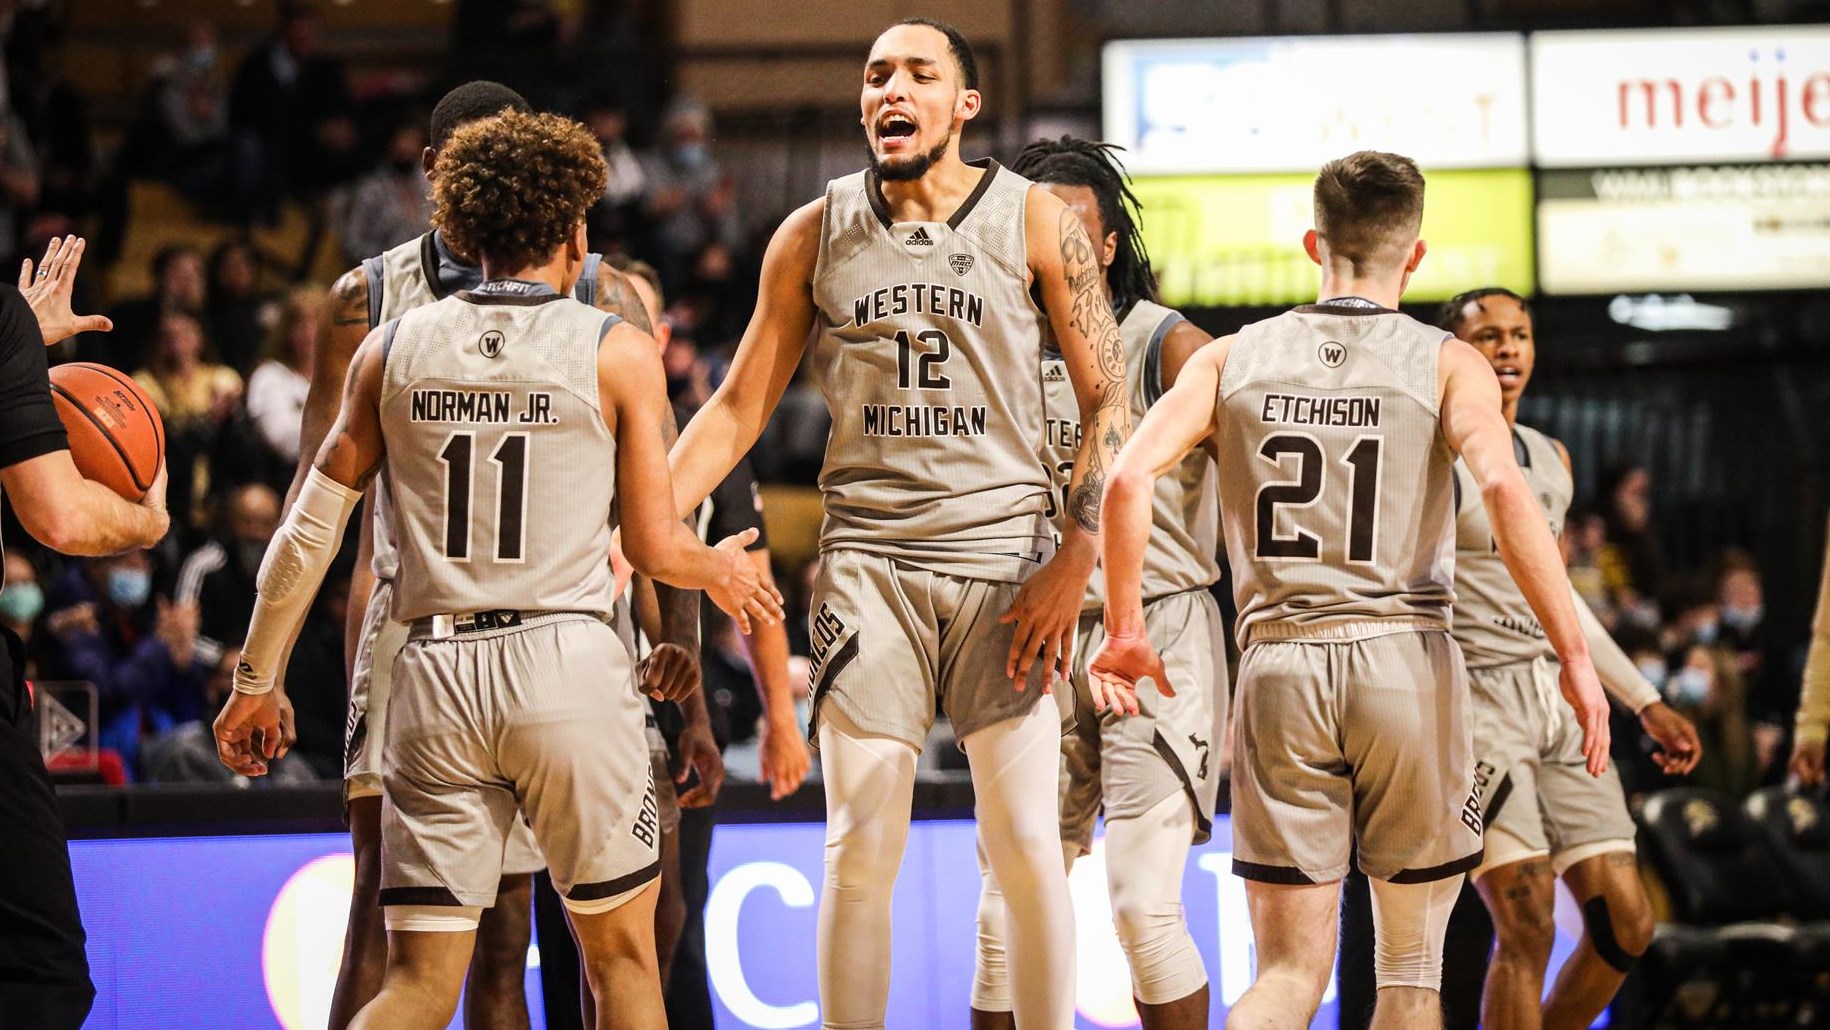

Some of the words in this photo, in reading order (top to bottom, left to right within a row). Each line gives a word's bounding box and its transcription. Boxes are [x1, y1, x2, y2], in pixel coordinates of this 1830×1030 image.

[905, 238, 934, 246] adidas
[487, 281, 531, 293] TECHFIT
[854, 283, 983, 329] WESTERN
[894, 329, 951, 391] 12
[411, 390, 511, 424] NORMAN
[519, 392, 559, 425] JR.
[862, 404, 986, 437] MICHIGAN
[1261, 392, 1382, 429] ETCHISON
[436, 430, 531, 563] 11
[1254, 431, 1384, 566] 21
